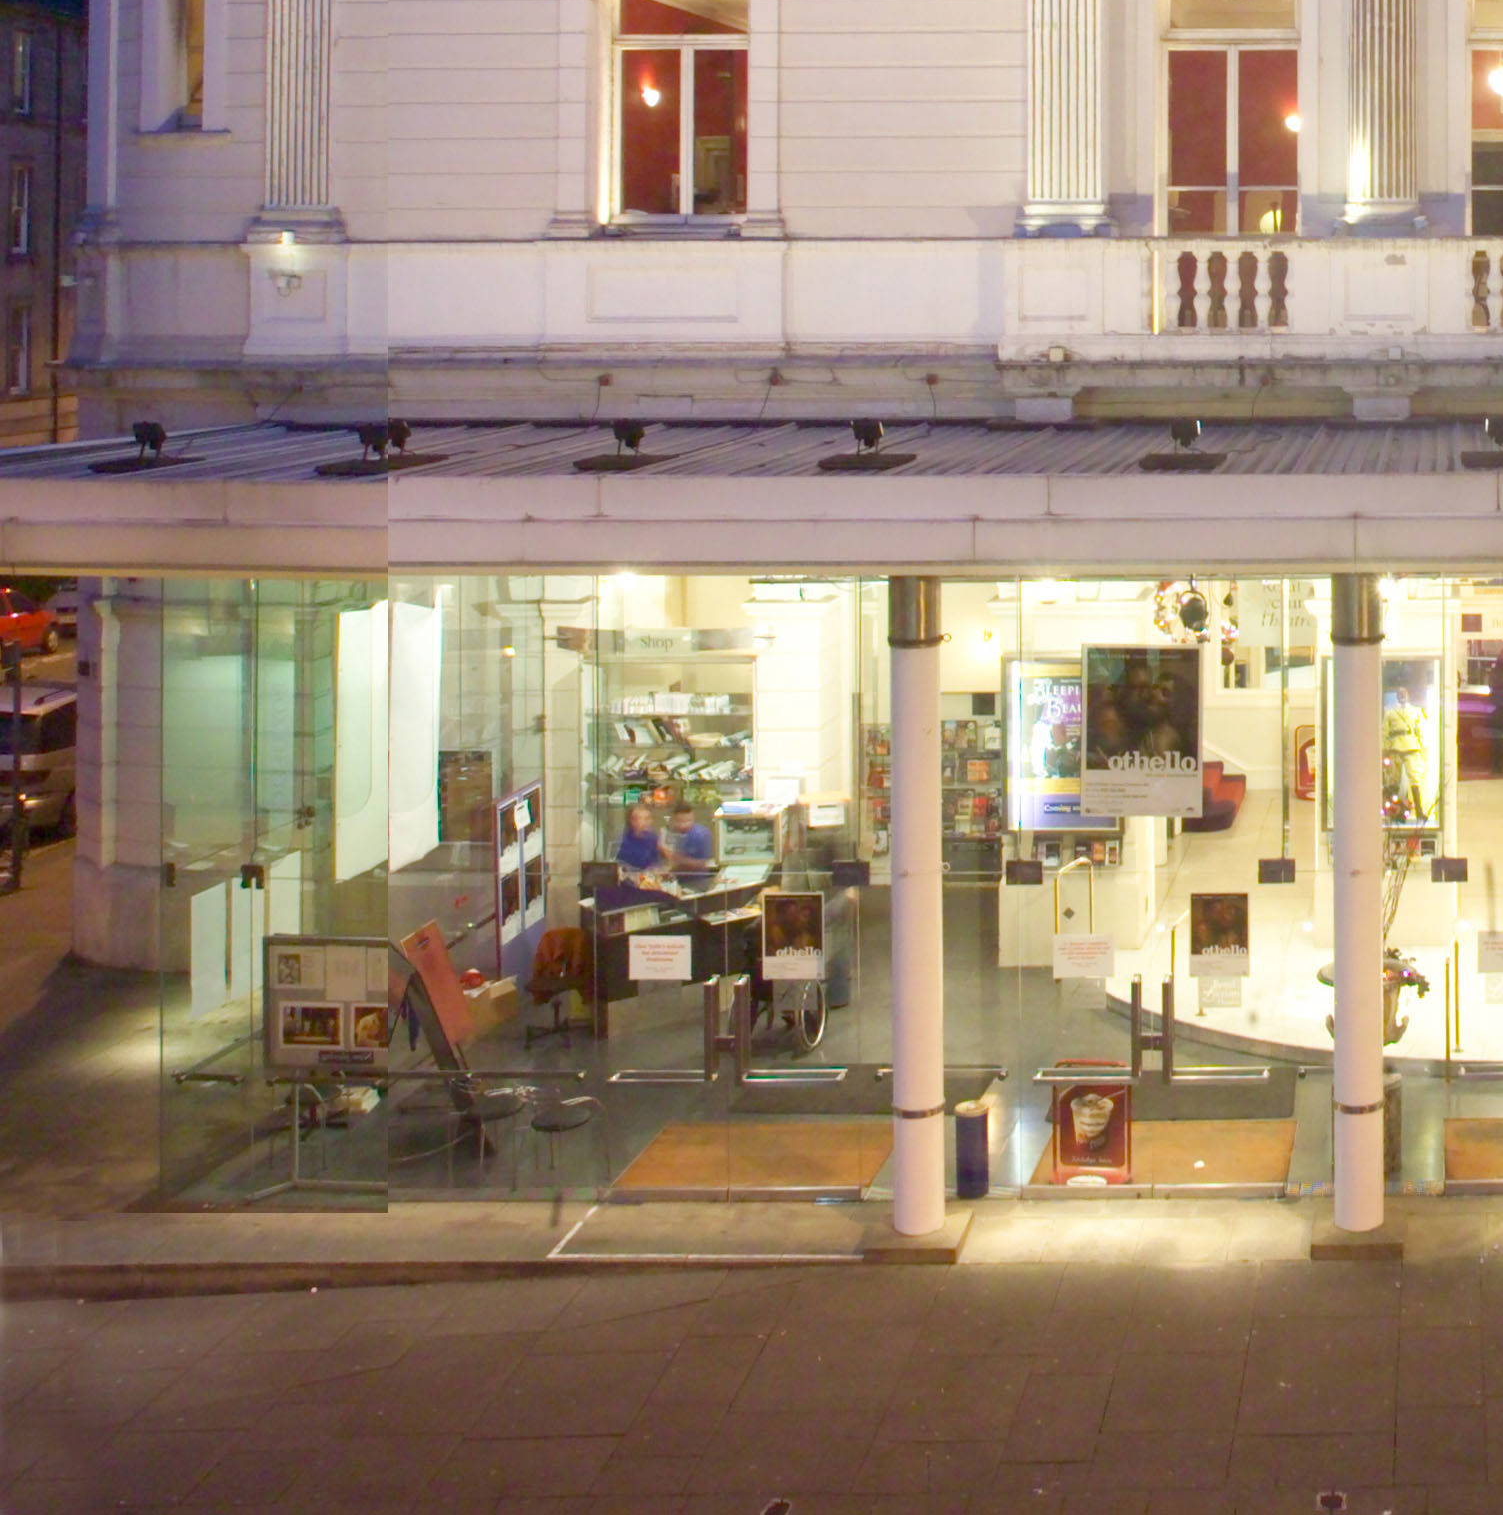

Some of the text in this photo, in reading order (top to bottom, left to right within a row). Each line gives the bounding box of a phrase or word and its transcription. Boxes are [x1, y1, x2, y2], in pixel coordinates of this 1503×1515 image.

[640, 634, 674, 653] Shop
[1107, 750, 1197, 772] othello
[775, 946, 822, 957] othello
[1201, 944, 1248, 956] othello
